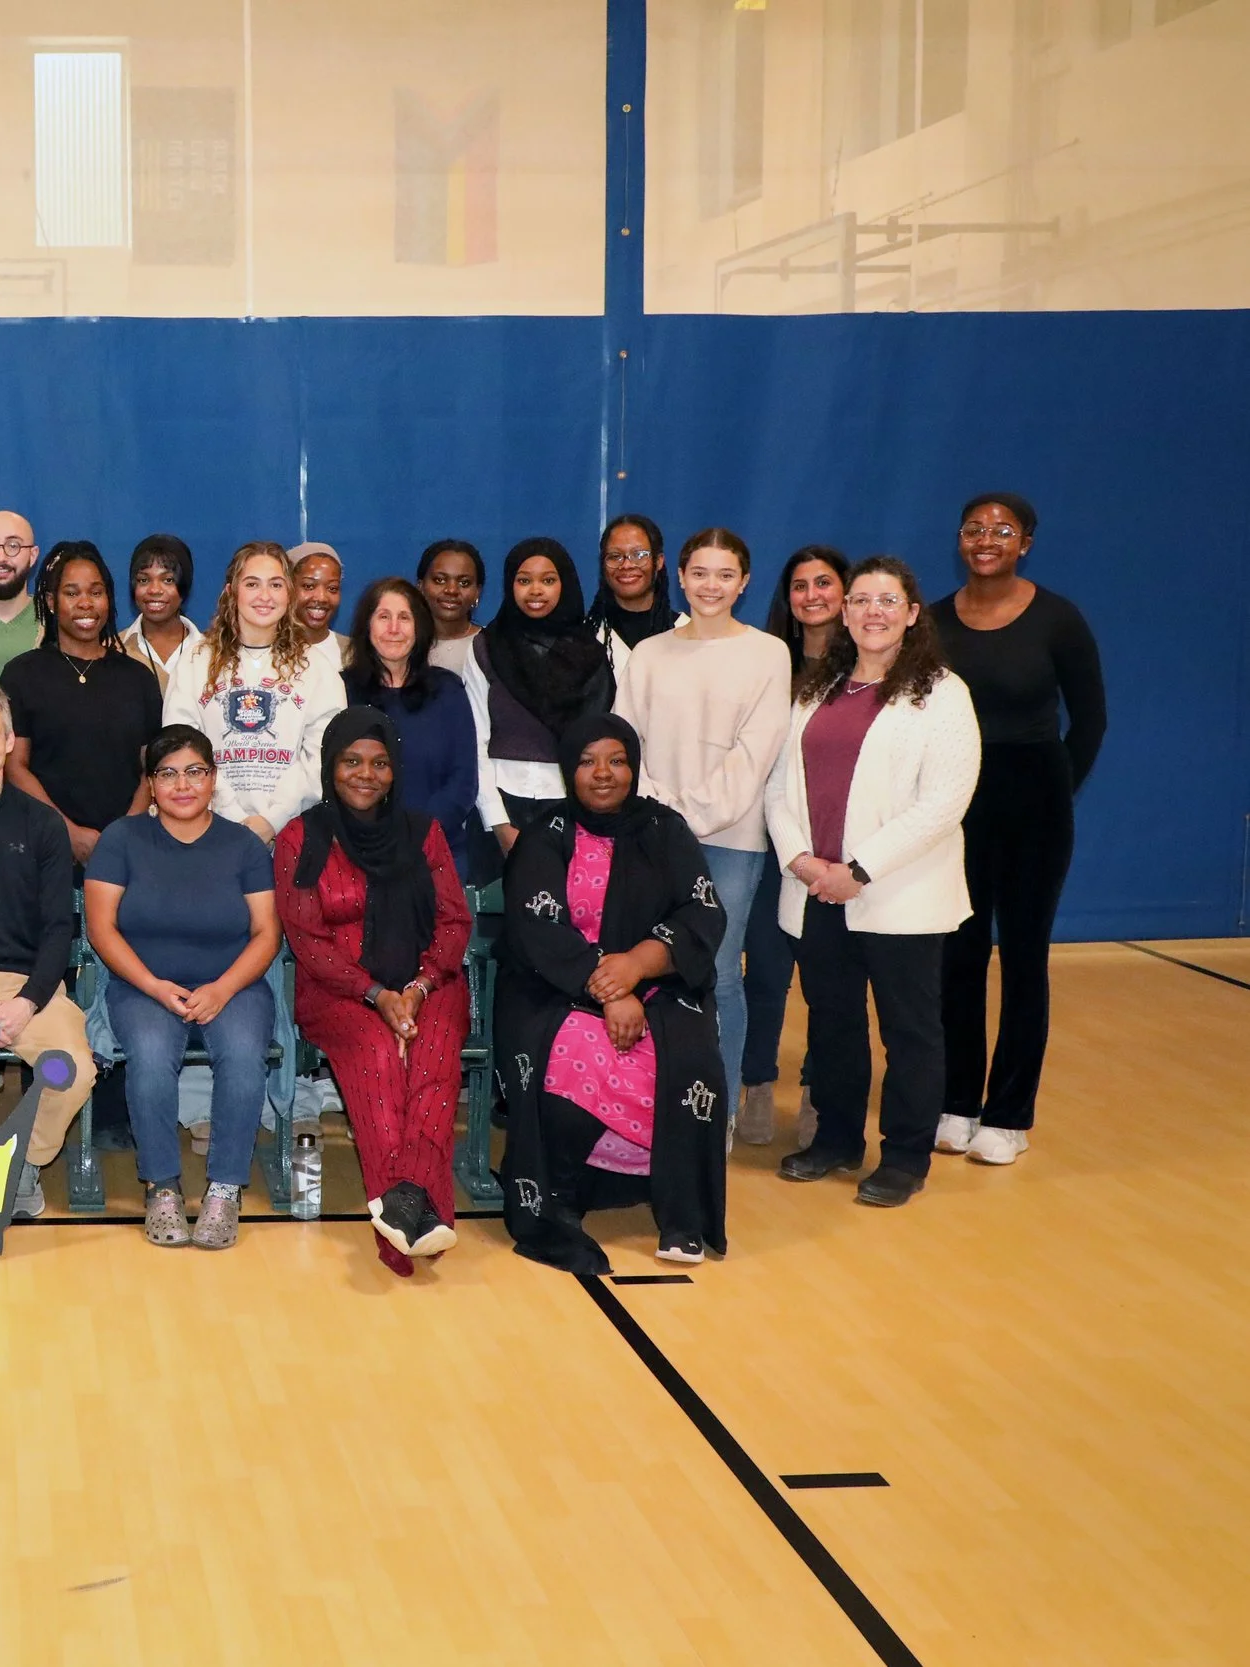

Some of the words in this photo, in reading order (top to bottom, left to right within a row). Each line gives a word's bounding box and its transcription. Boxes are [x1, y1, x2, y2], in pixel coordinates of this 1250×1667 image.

[259, 677, 305, 710] SOX
[224, 740, 249, 748] World
[213, 748, 294, 765] HAMPION
